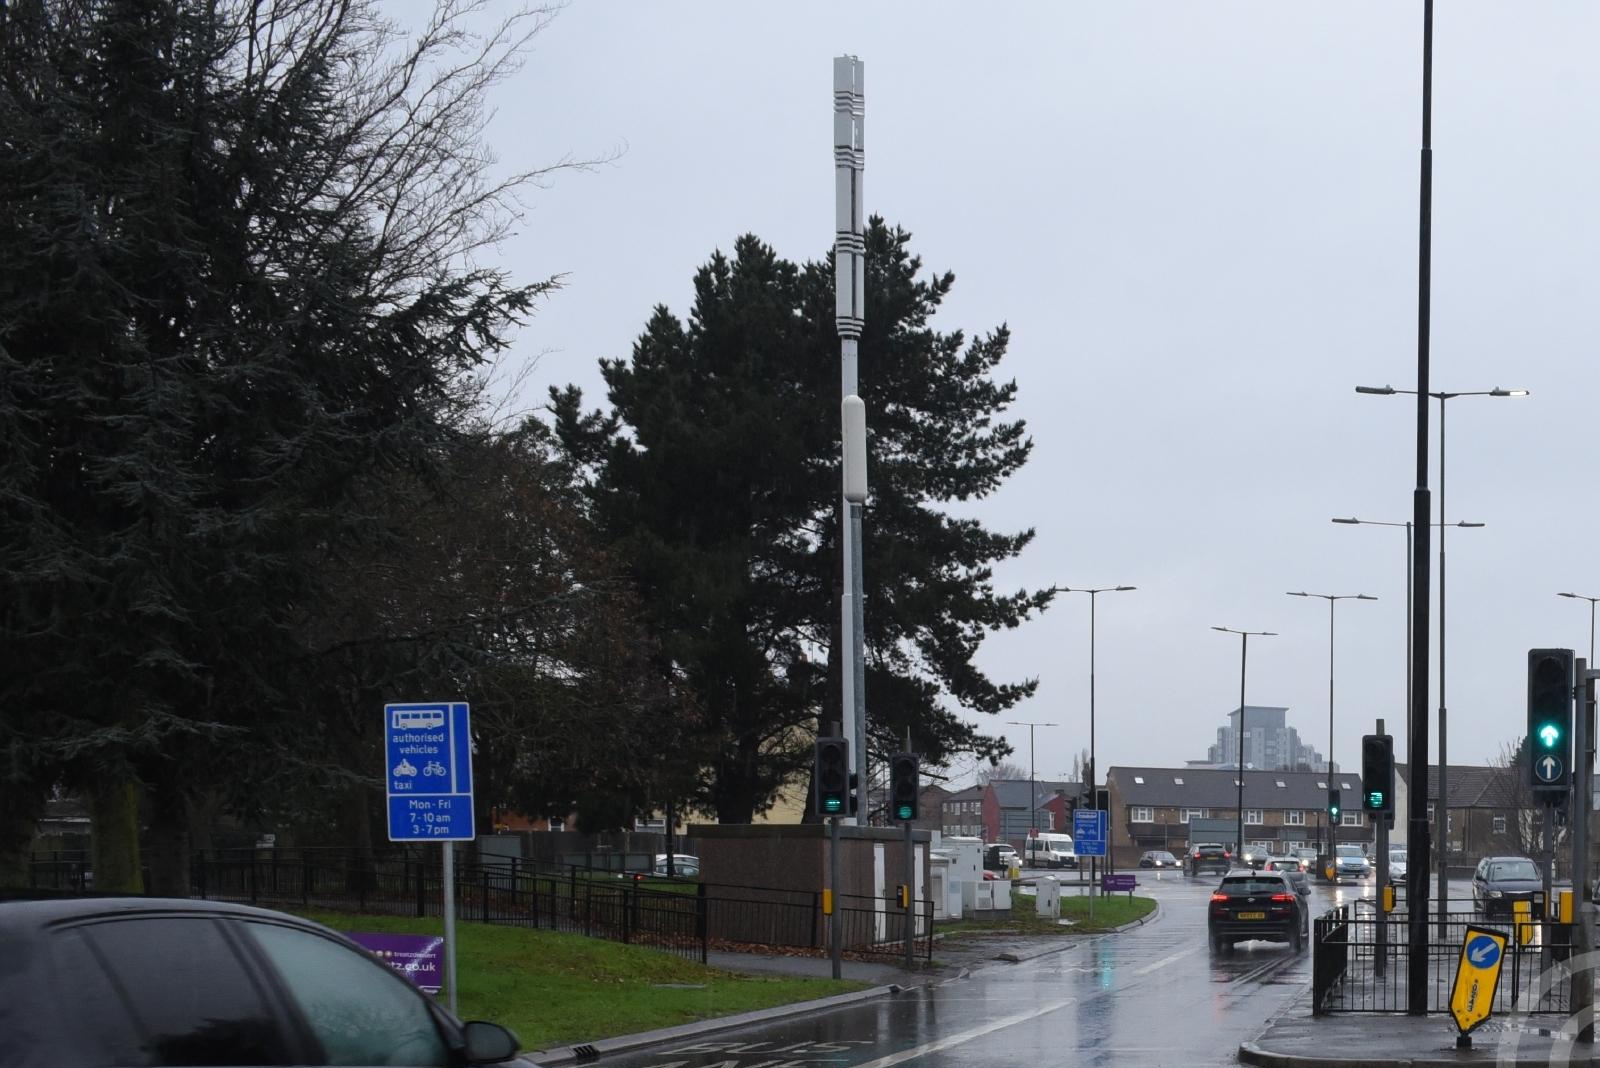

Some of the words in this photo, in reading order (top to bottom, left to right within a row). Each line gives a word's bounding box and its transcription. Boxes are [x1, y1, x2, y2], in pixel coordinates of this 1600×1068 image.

[392, 732, 445, 744] authorised
[399, 744, 439, 755] vehicles
[393, 780, 413, 790] taxi
[409, 799, 431, 810] Mon
[438, 799, 452, 810] Fri
[657, 1040, 875, 1055] BUS
